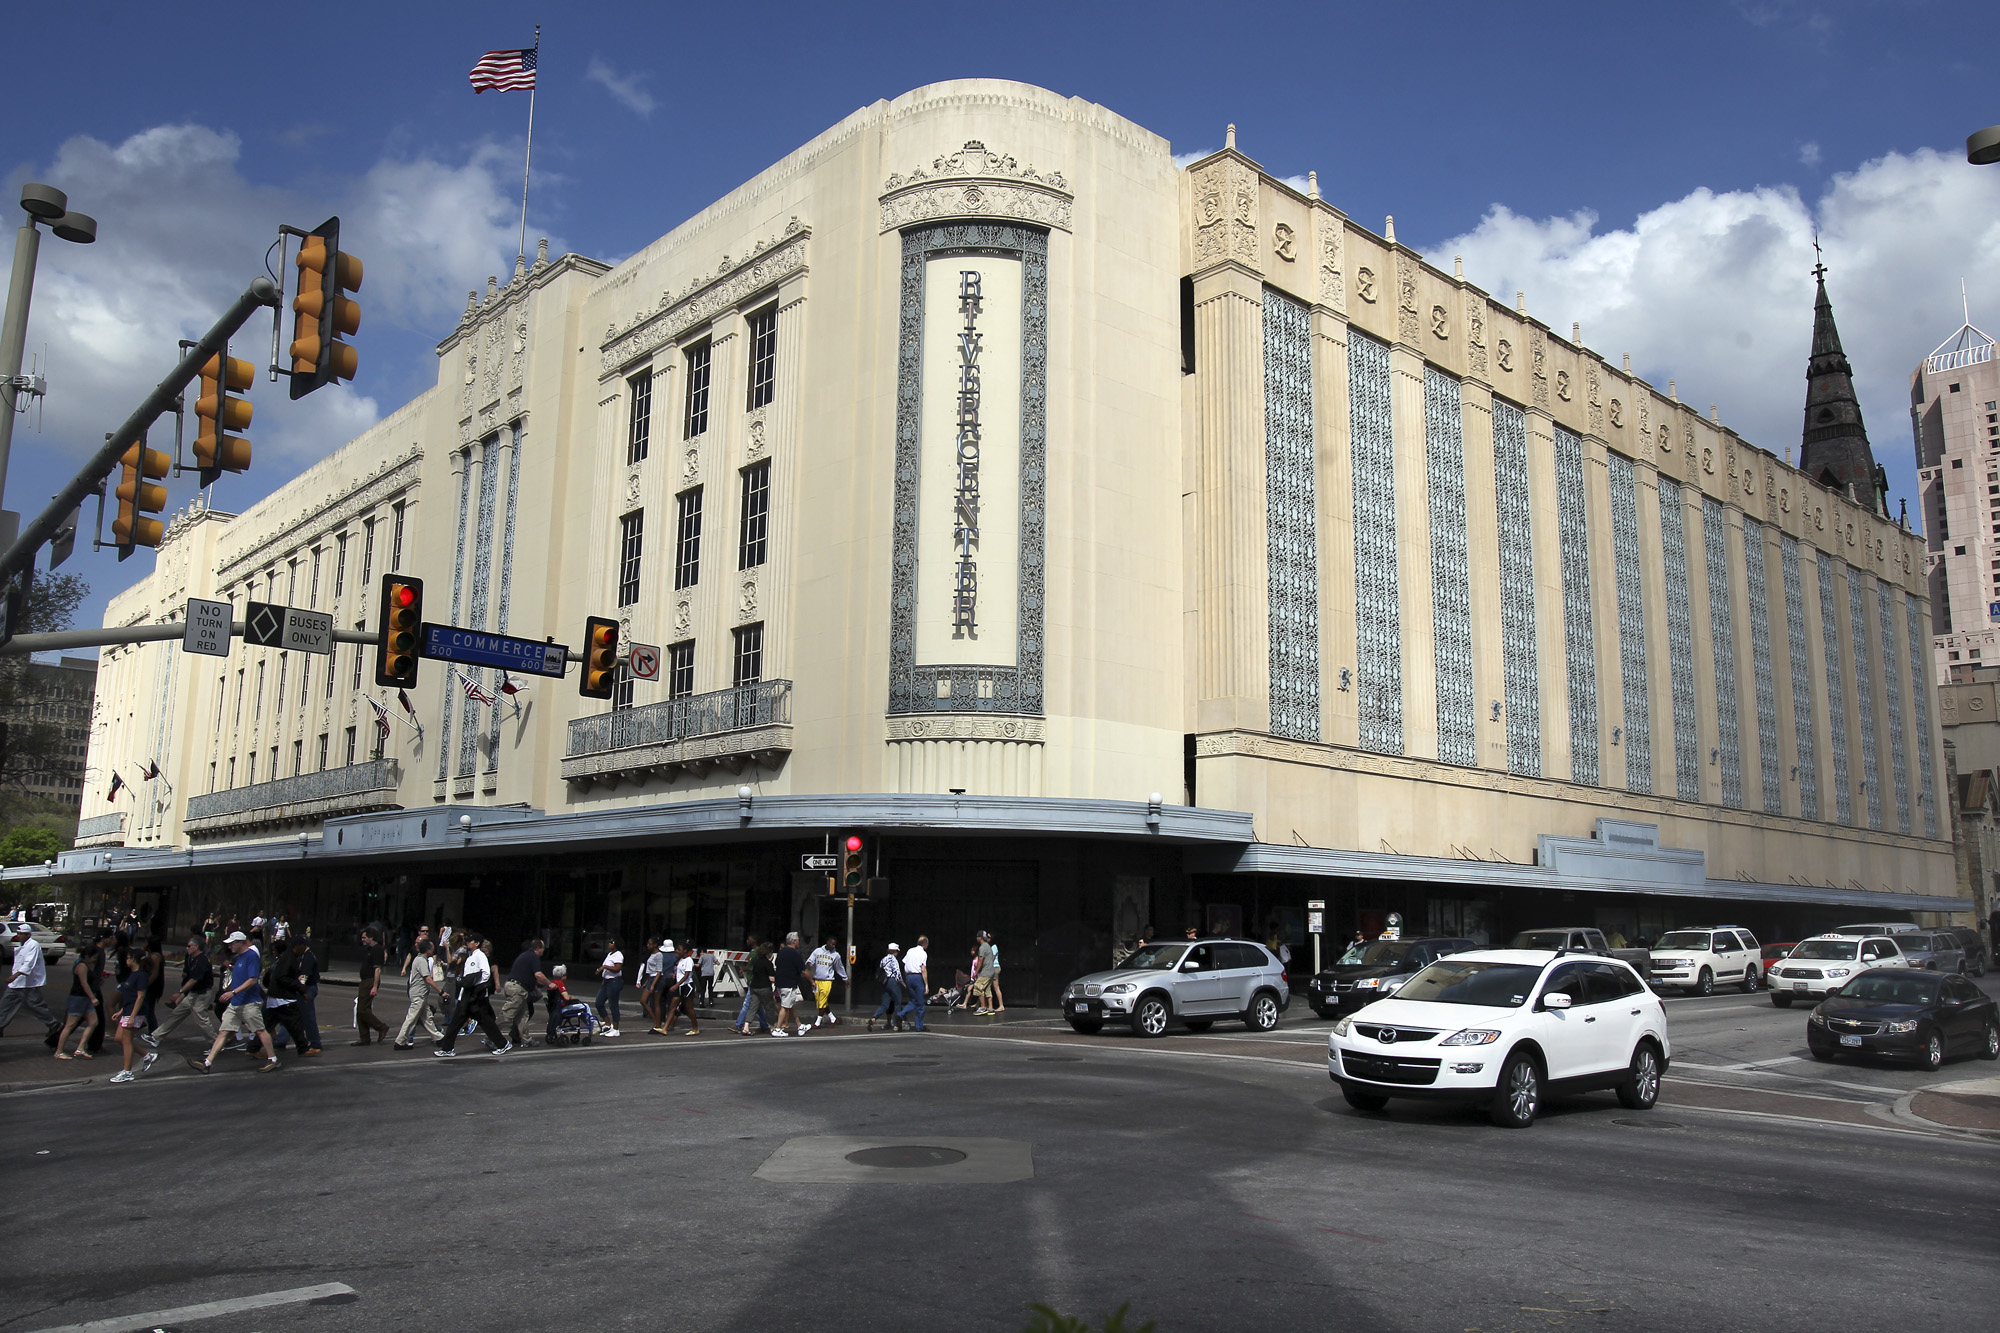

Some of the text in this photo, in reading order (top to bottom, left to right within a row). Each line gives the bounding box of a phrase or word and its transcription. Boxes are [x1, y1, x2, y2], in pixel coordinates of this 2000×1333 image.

[953, 270, 983, 627] RIVERCENTER
[200, 604, 221, 617] NO
[196, 617, 223, 629] TURN
[289, 615, 327, 632] BUSES
[200, 630, 216, 639] ON
[291, 631, 322, 646] ONLY
[196, 640, 217, 651] RED
[431, 629, 543, 658] E COMMERCE
[431, 645, 452, 657] 500
[520, 660, 540, 670] 600
